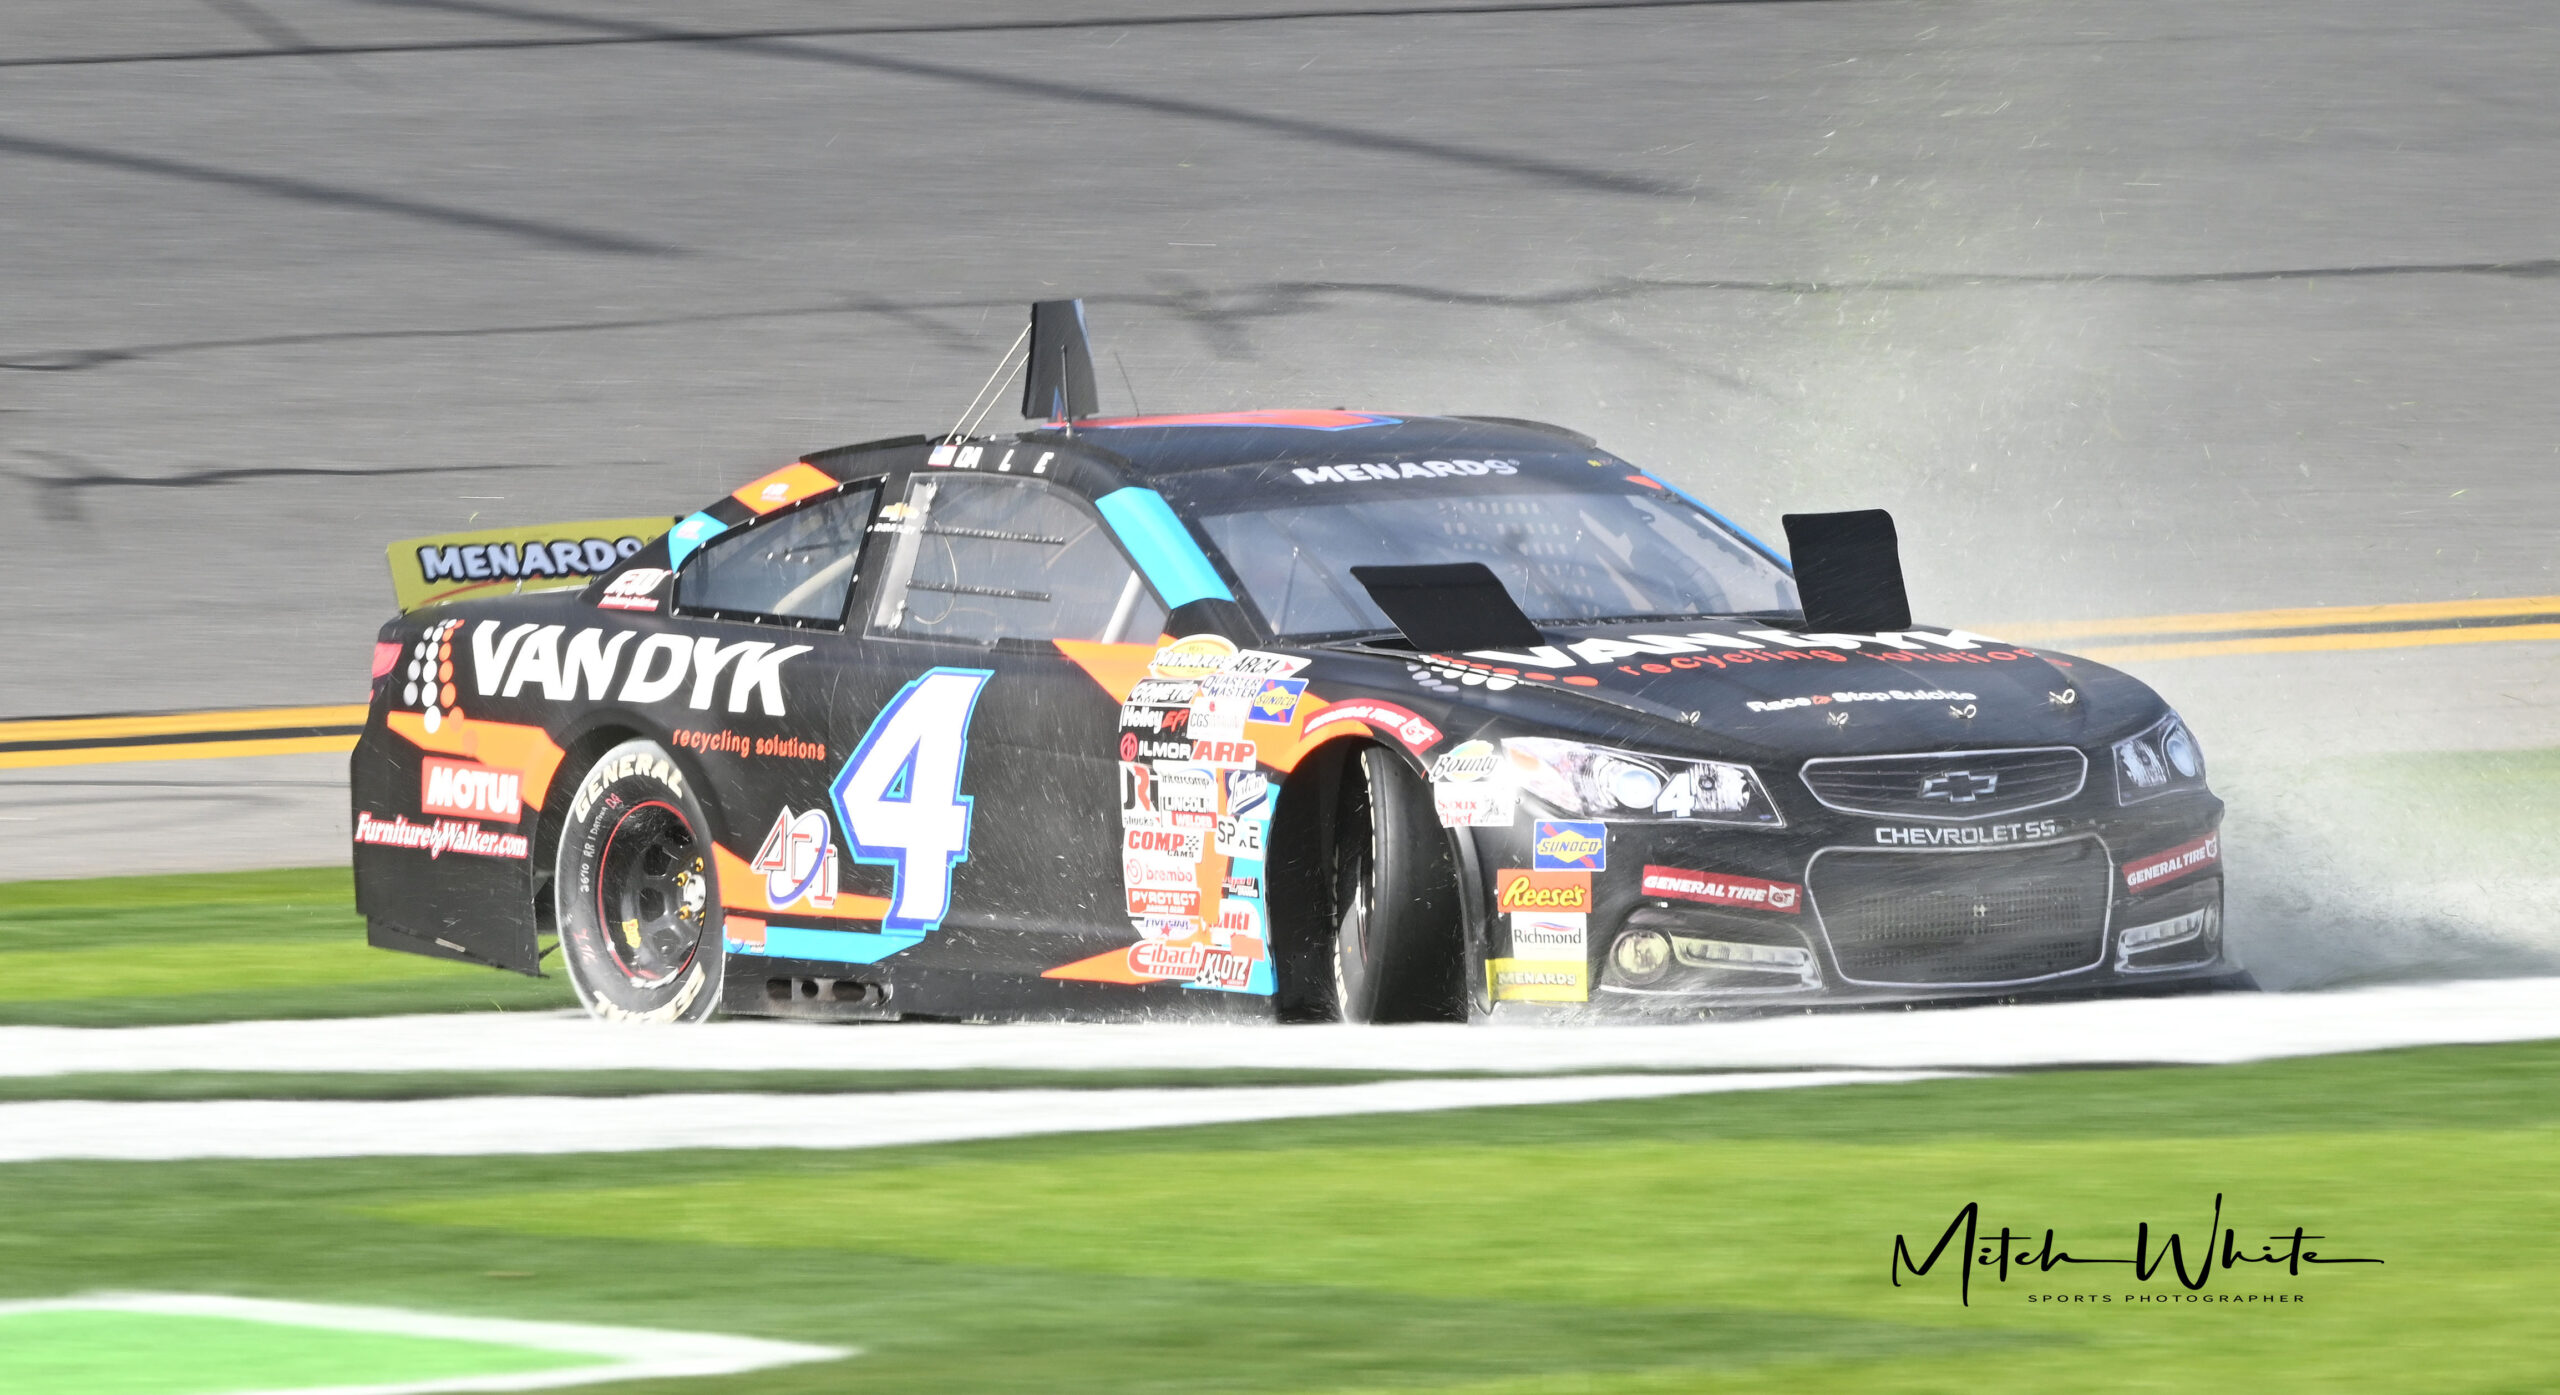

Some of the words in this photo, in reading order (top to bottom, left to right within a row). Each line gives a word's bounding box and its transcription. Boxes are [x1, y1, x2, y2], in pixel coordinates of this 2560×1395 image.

[1292, 459, 1519, 485] MENARDS
[1462, 631, 1767, 669] VAN
[1617, 647, 1848, 677] recycling
[472, 620, 637, 701] VAN
[618, 632, 814, 717] DYK
[1208, 685, 1258, 699] MASTER
[1256, 694, 1297, 707] SUNOCO
[1122, 705, 1164, 734] Holley
[672, 728, 750, 758] recycling
[755, 734, 826, 761] solutions
[1139, 740, 1191, 760] ILMOR
[1192, 740, 1255, 763] ARP
[1432, 755, 1499, 778] Bounty
[427, 765, 520, 814] MOTUL
[575, 753, 682, 824] GENERAL
[829, 666, 996, 938] 4
[1653, 772, 1696, 818] 4
[1128, 830, 1185, 852] COMP
[1540, 841, 1599, 853] SUNOCO
[1875, 823, 2022, 845] CHEVROLET
[1146, 865, 1193, 883] brembo
[2126, 856, 2183, 886] GENERAL
[2182, 846, 2206, 866] TIRE
[1131, 891, 1197, 906] PYROTECT
[1502, 876, 1587, 907] Reese's
[1643, 875, 1725, 898] GENERAL
[1727, 885, 1768, 902] TIRE
[1513, 927, 1582, 945] Richmond
[1129, 942, 1200, 975] Eibach
[1204, 951, 1249, 981] KLOTZ
[1498, 971, 1577, 986] MENARDS
